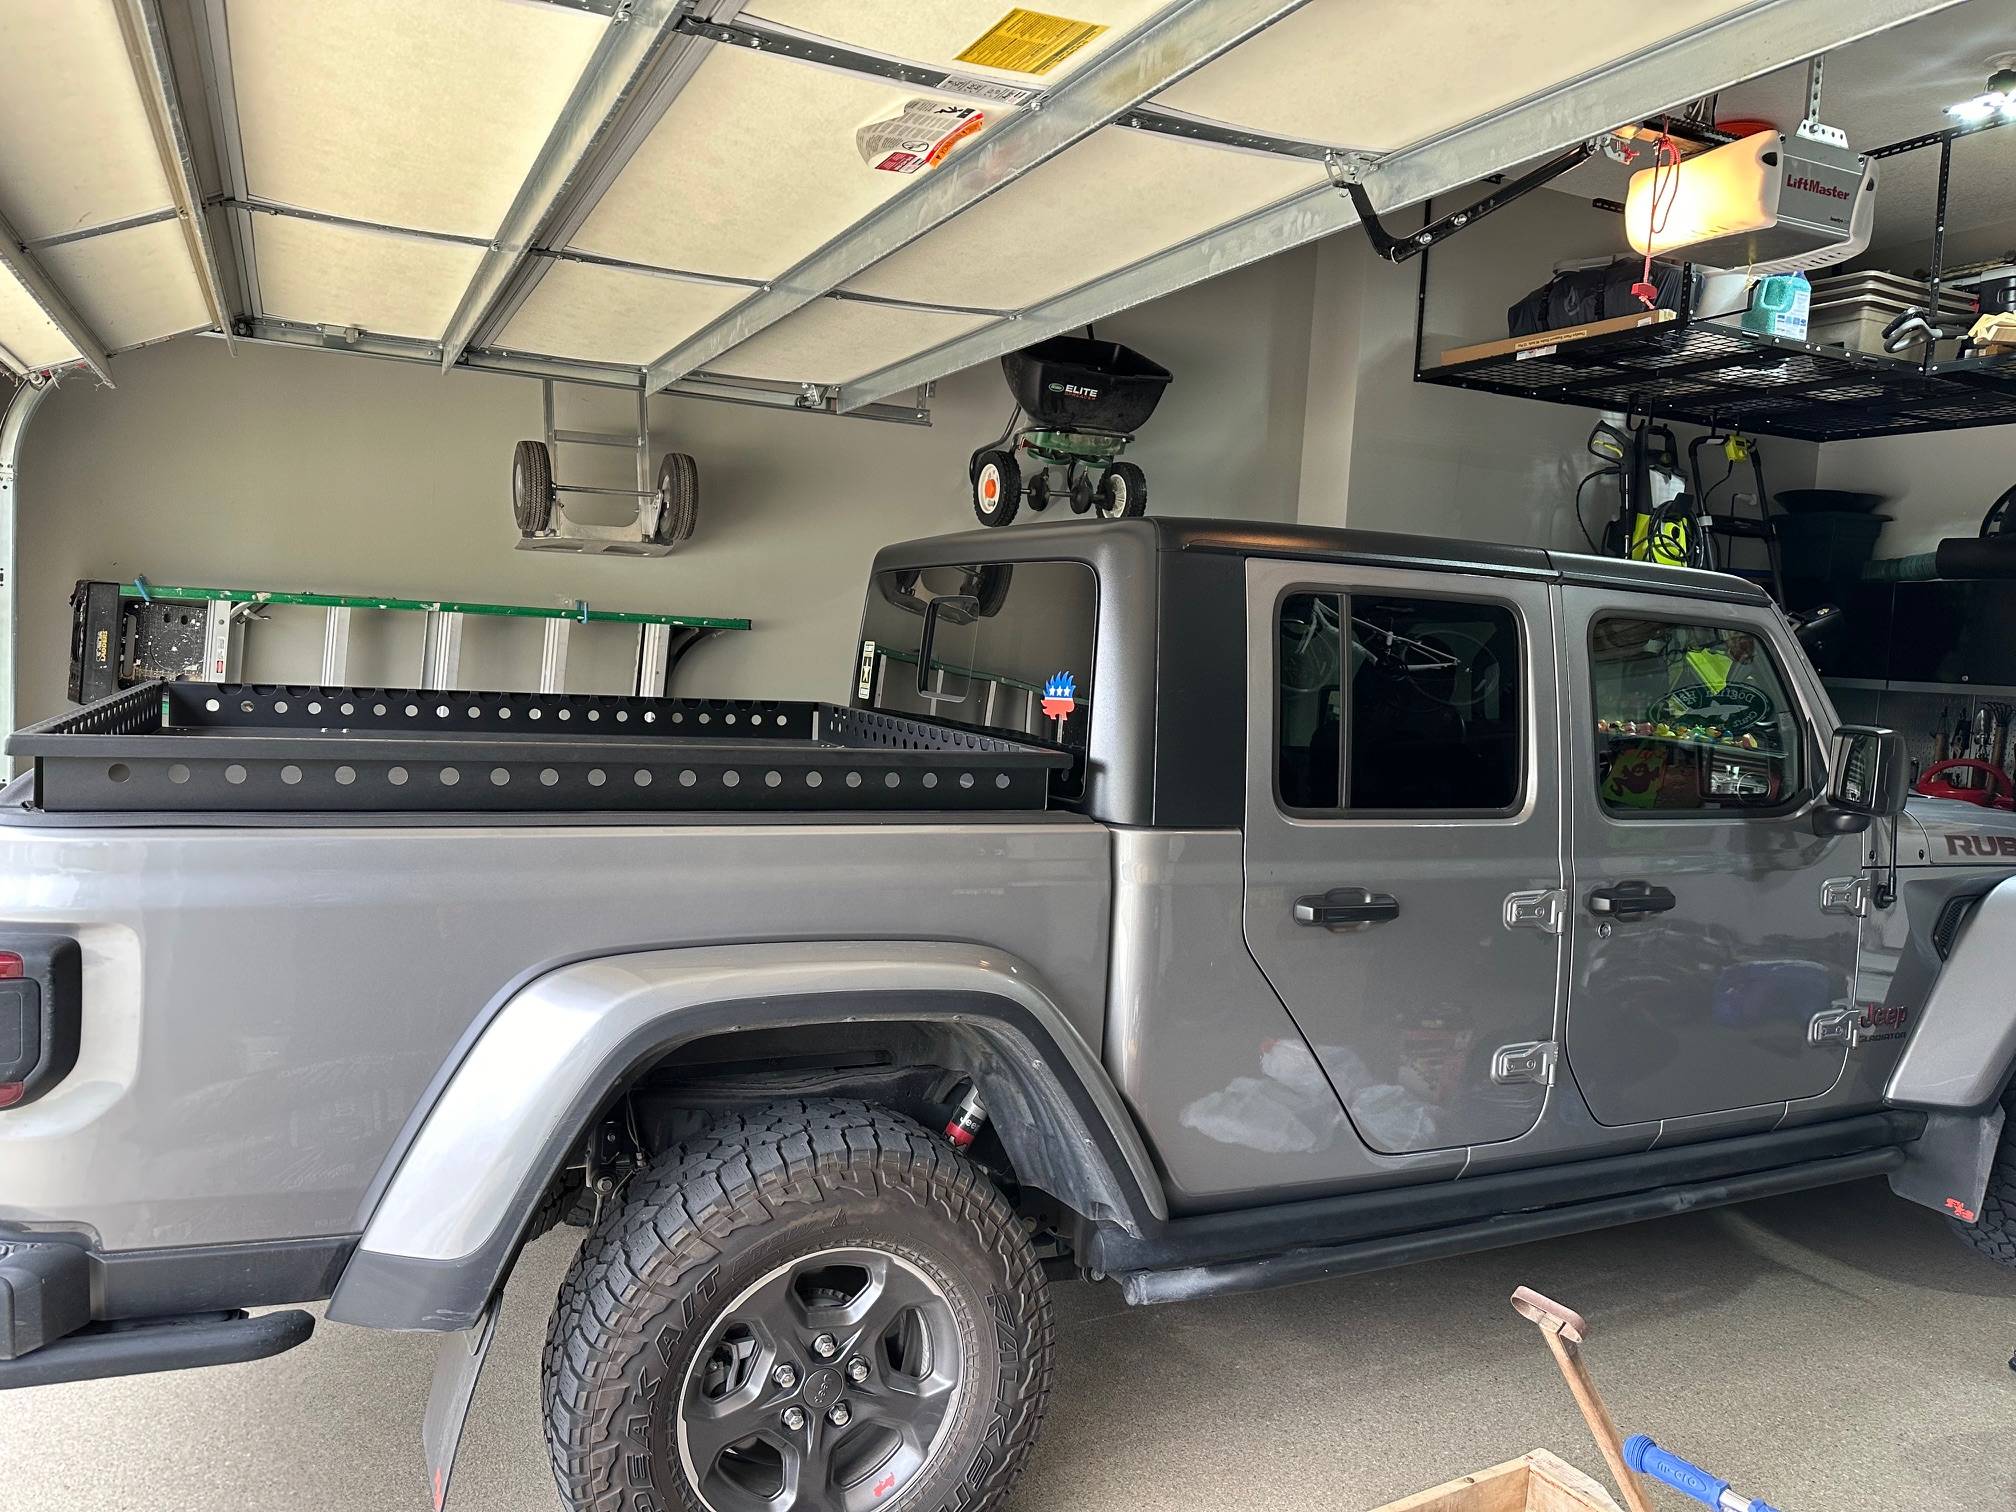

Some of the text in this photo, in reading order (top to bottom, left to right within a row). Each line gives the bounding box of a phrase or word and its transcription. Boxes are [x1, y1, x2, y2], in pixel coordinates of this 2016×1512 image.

[1786, 174, 1850, 200] LiftMaster
[1065, 384, 1098, 397] ELITE
[1944, 834, 2016, 856] RUB
[1860, 1002, 1906, 1029] Jeep
[814, 1373, 829, 1403] Jeep
